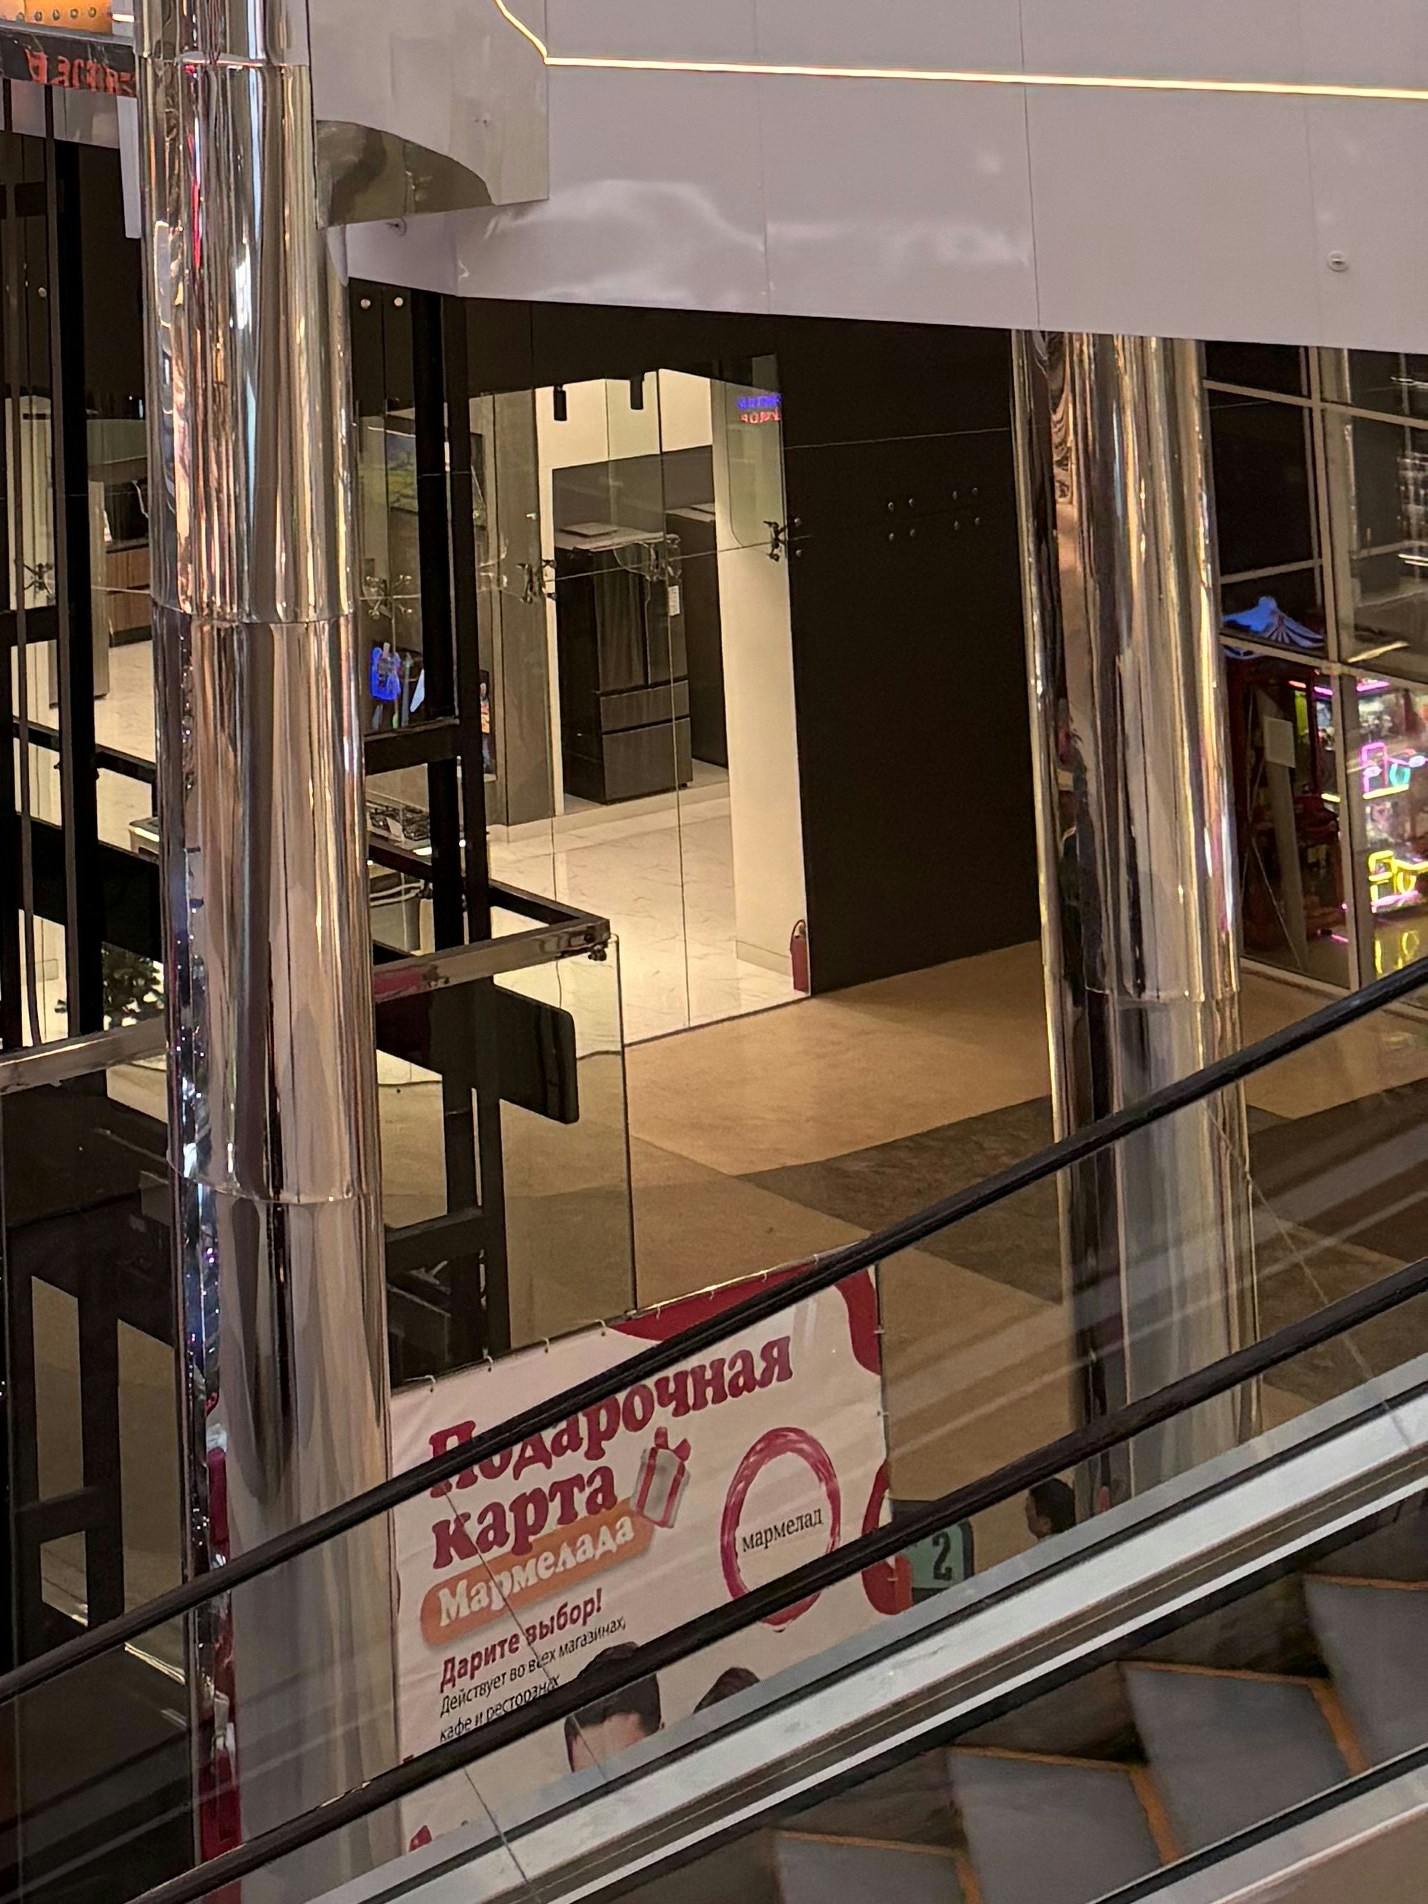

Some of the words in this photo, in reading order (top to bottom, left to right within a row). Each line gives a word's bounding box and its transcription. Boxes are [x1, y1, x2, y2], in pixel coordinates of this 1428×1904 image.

[432, 1465, 618, 1570] карта
[741, 1508, 824, 1553] мармелад
[437, 1511, 635, 1628] Мармелада
[439, 1632, 521, 1693] Дарите
[525, 1587, 603, 1646] выбор!
[440, 1671, 507, 1718] Действует
[509, 1663, 526, 1679] во
[528, 1649, 556, 1674] всех
[558, 1616, 627, 1658] магазинах,
[439, 1717, 472, 1743] кафе
